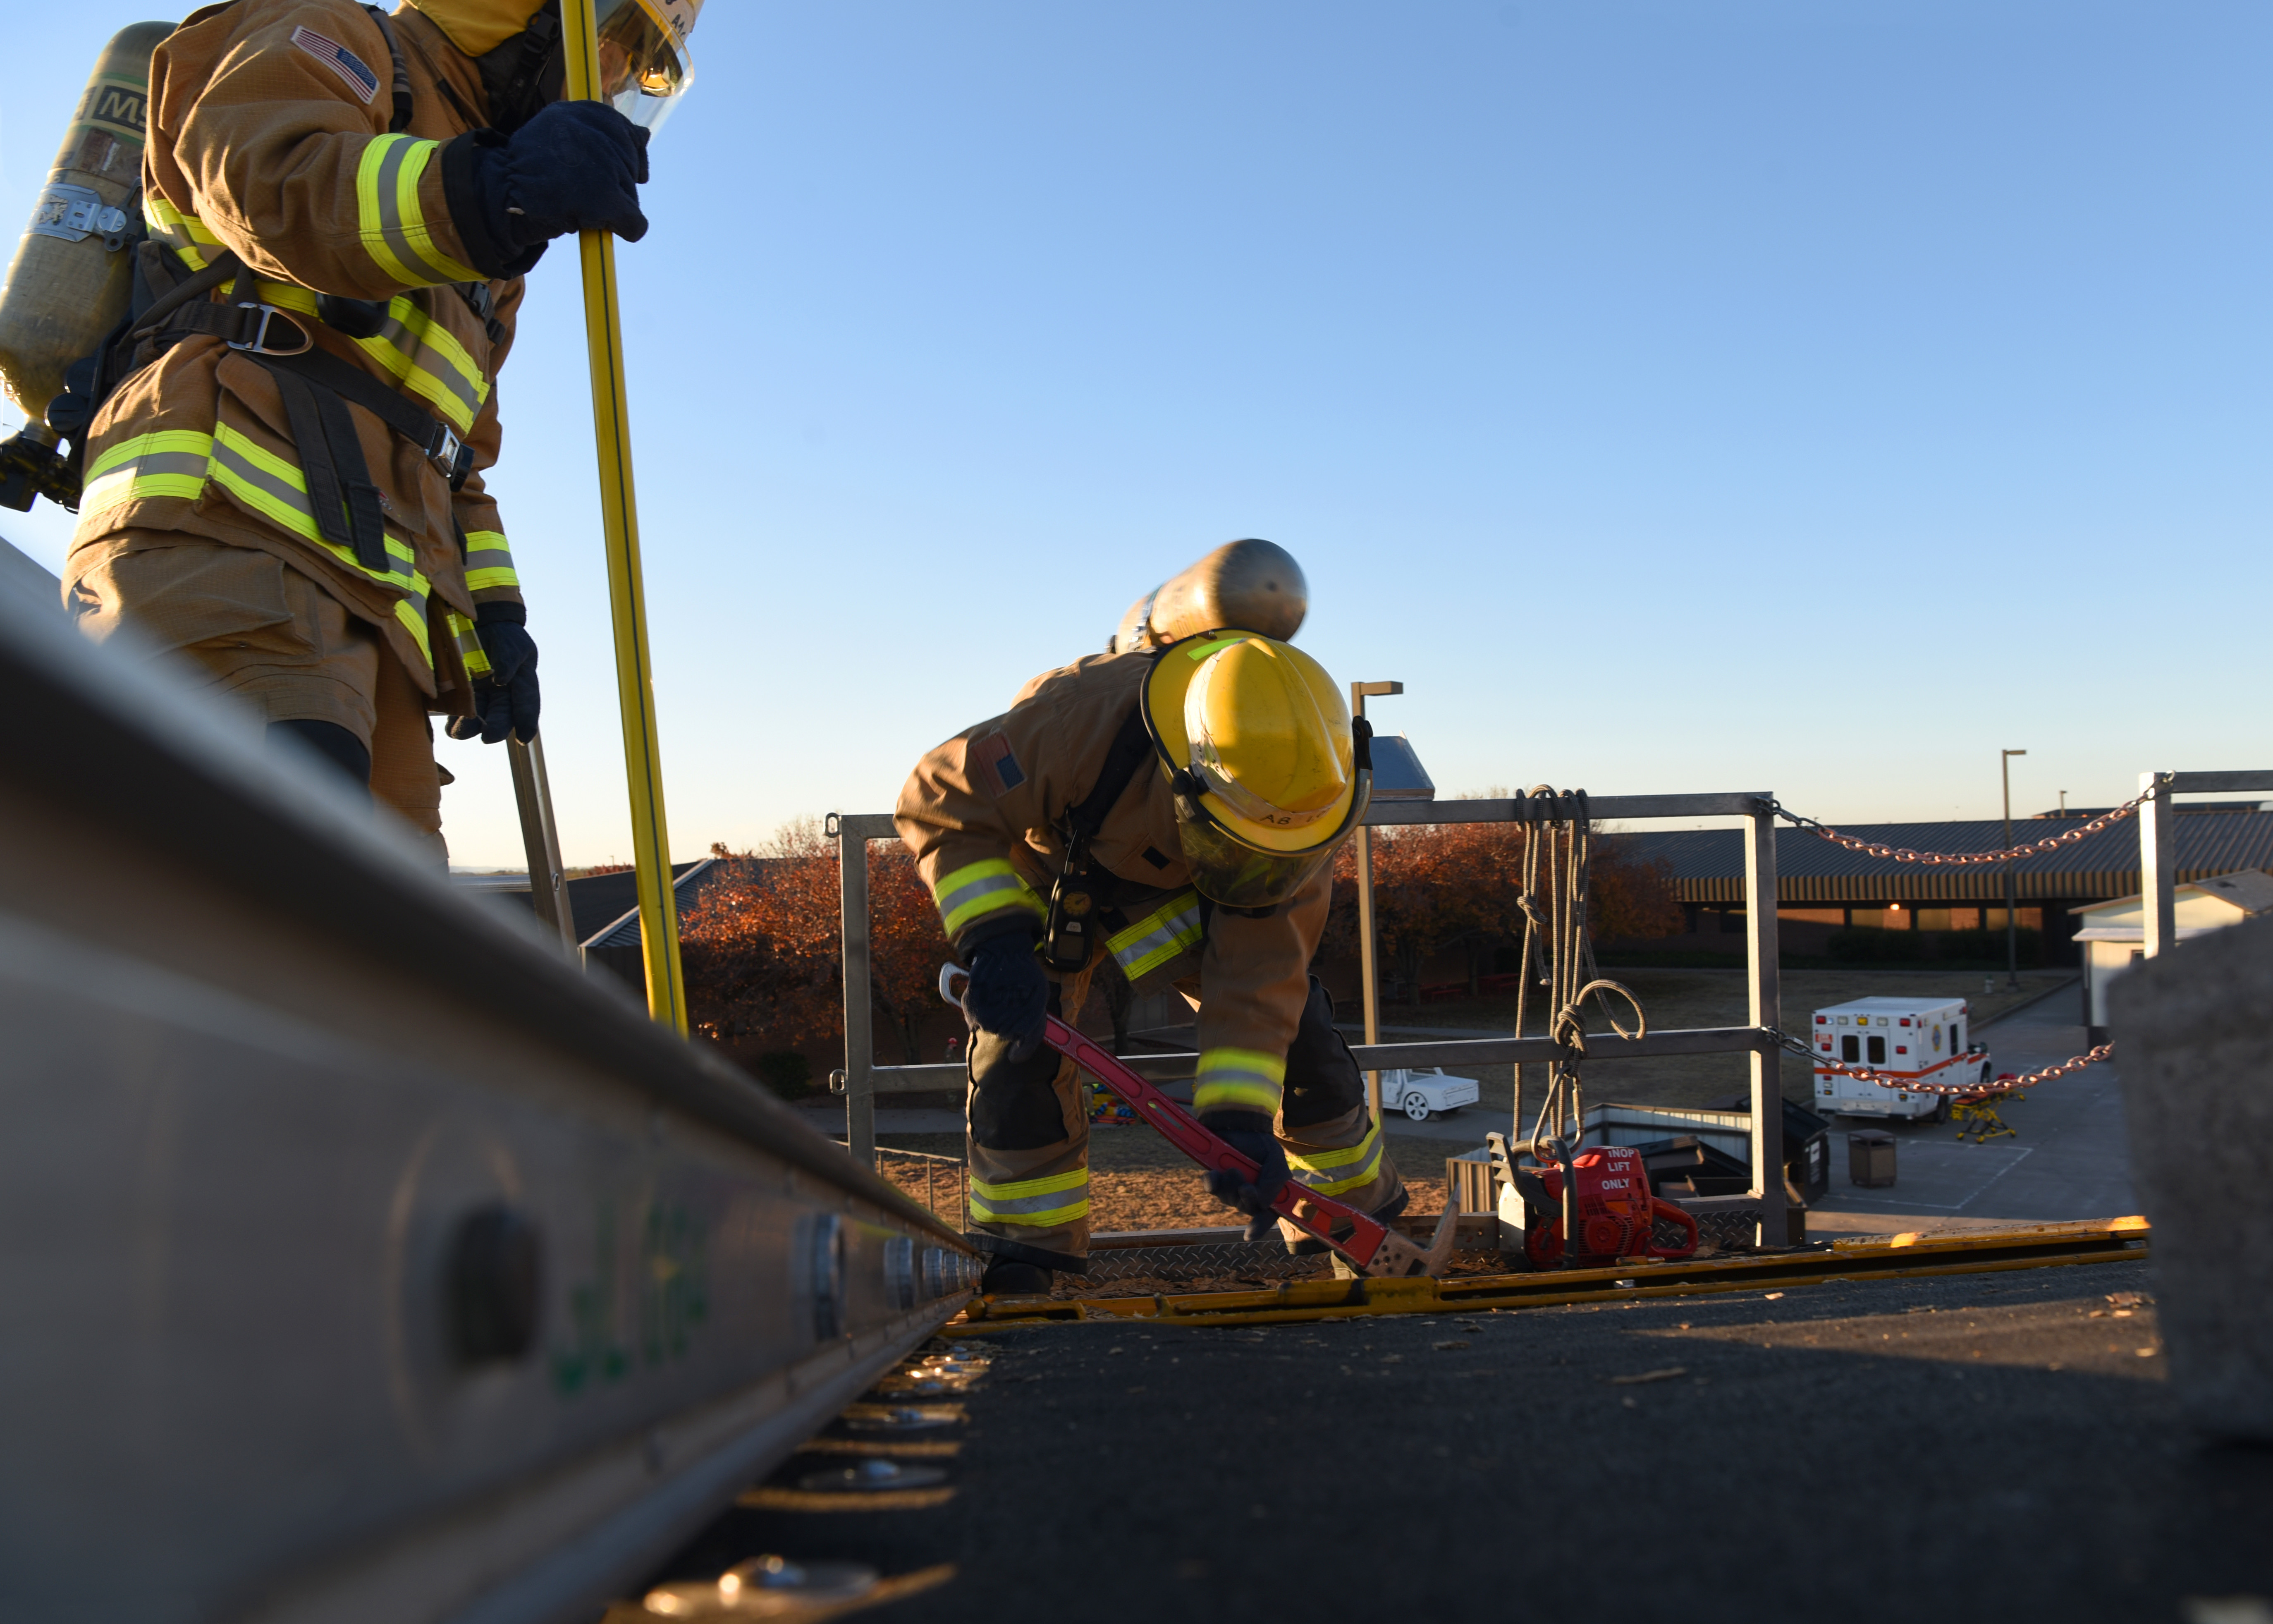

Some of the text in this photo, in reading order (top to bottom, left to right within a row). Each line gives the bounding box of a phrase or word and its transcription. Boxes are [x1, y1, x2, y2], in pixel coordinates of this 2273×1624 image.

[1608, 1148, 1635, 1158] INOP
[1607, 1162, 1630, 1172] LIFT
[1601, 1178, 1630, 1190] ONLY
